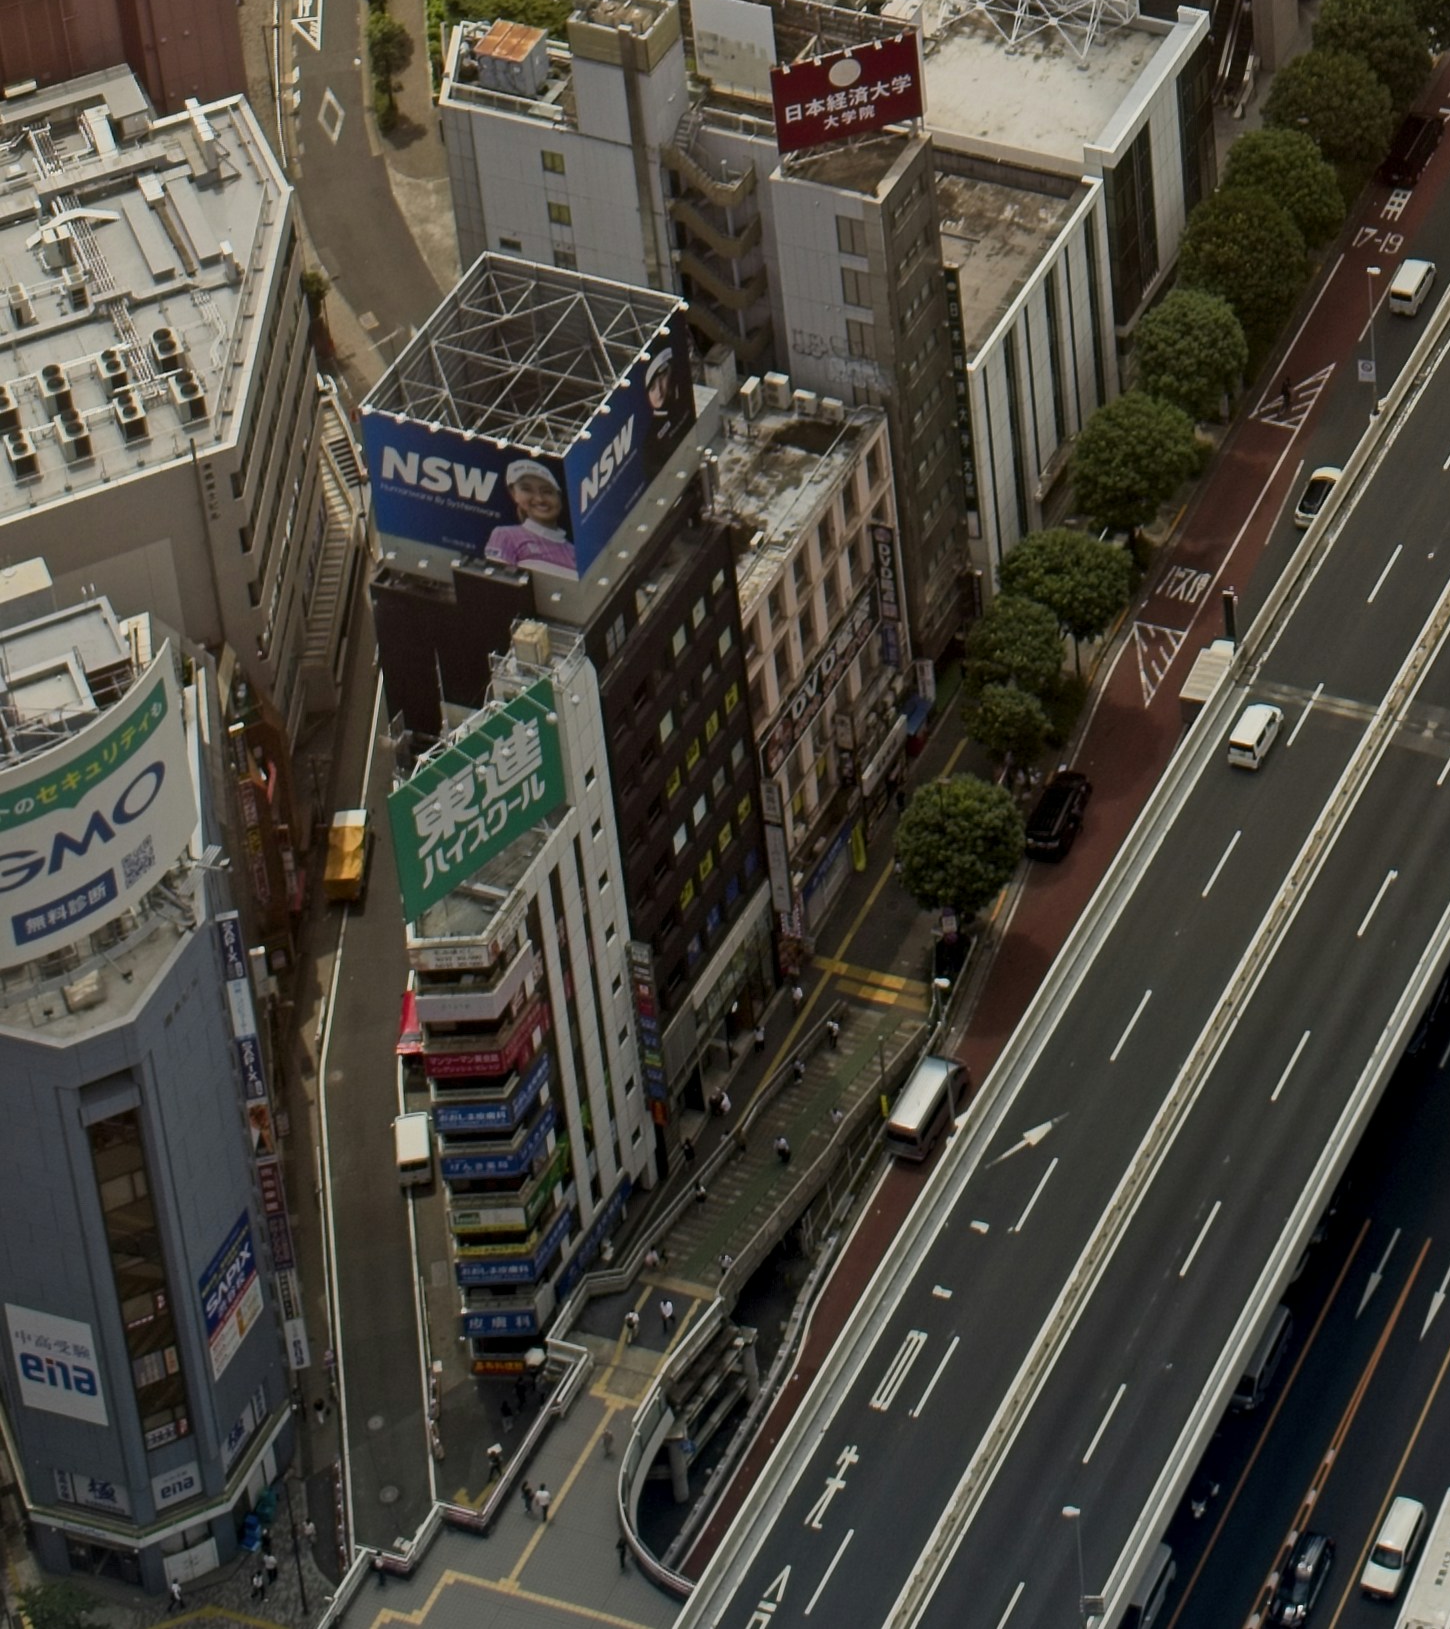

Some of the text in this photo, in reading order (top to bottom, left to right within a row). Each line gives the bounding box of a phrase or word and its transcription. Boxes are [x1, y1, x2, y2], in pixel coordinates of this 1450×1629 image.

[785, 73, 912, 124] 日本経済大学
[823, 104, 876, 131] 大学院
[381, 445, 498, 503] NSW
[580, 413, 634, 513] NSW
[380, 482, 500, 518] Humanware By Systemware
[412, 717, 543, 859] 東進
[0, 761, 165, 894] GMO
[422, 772, 545, 889] ハイスクール
[24, 881, 107, 934] 無料診断
[221, 921, 239, 963] SAPIX
[240, 1039, 259, 1083] SAPIX
[205, 1241, 252, 1320] SAPIX
[14, 1328, 91, 1359] 中高受験
[469, 1315, 531, 1329] 皮膚科
[19, 1352, 98, 1397] ena
[88, 1477, 117, 1503] 極
[161, 1475, 195, 1499] ena
